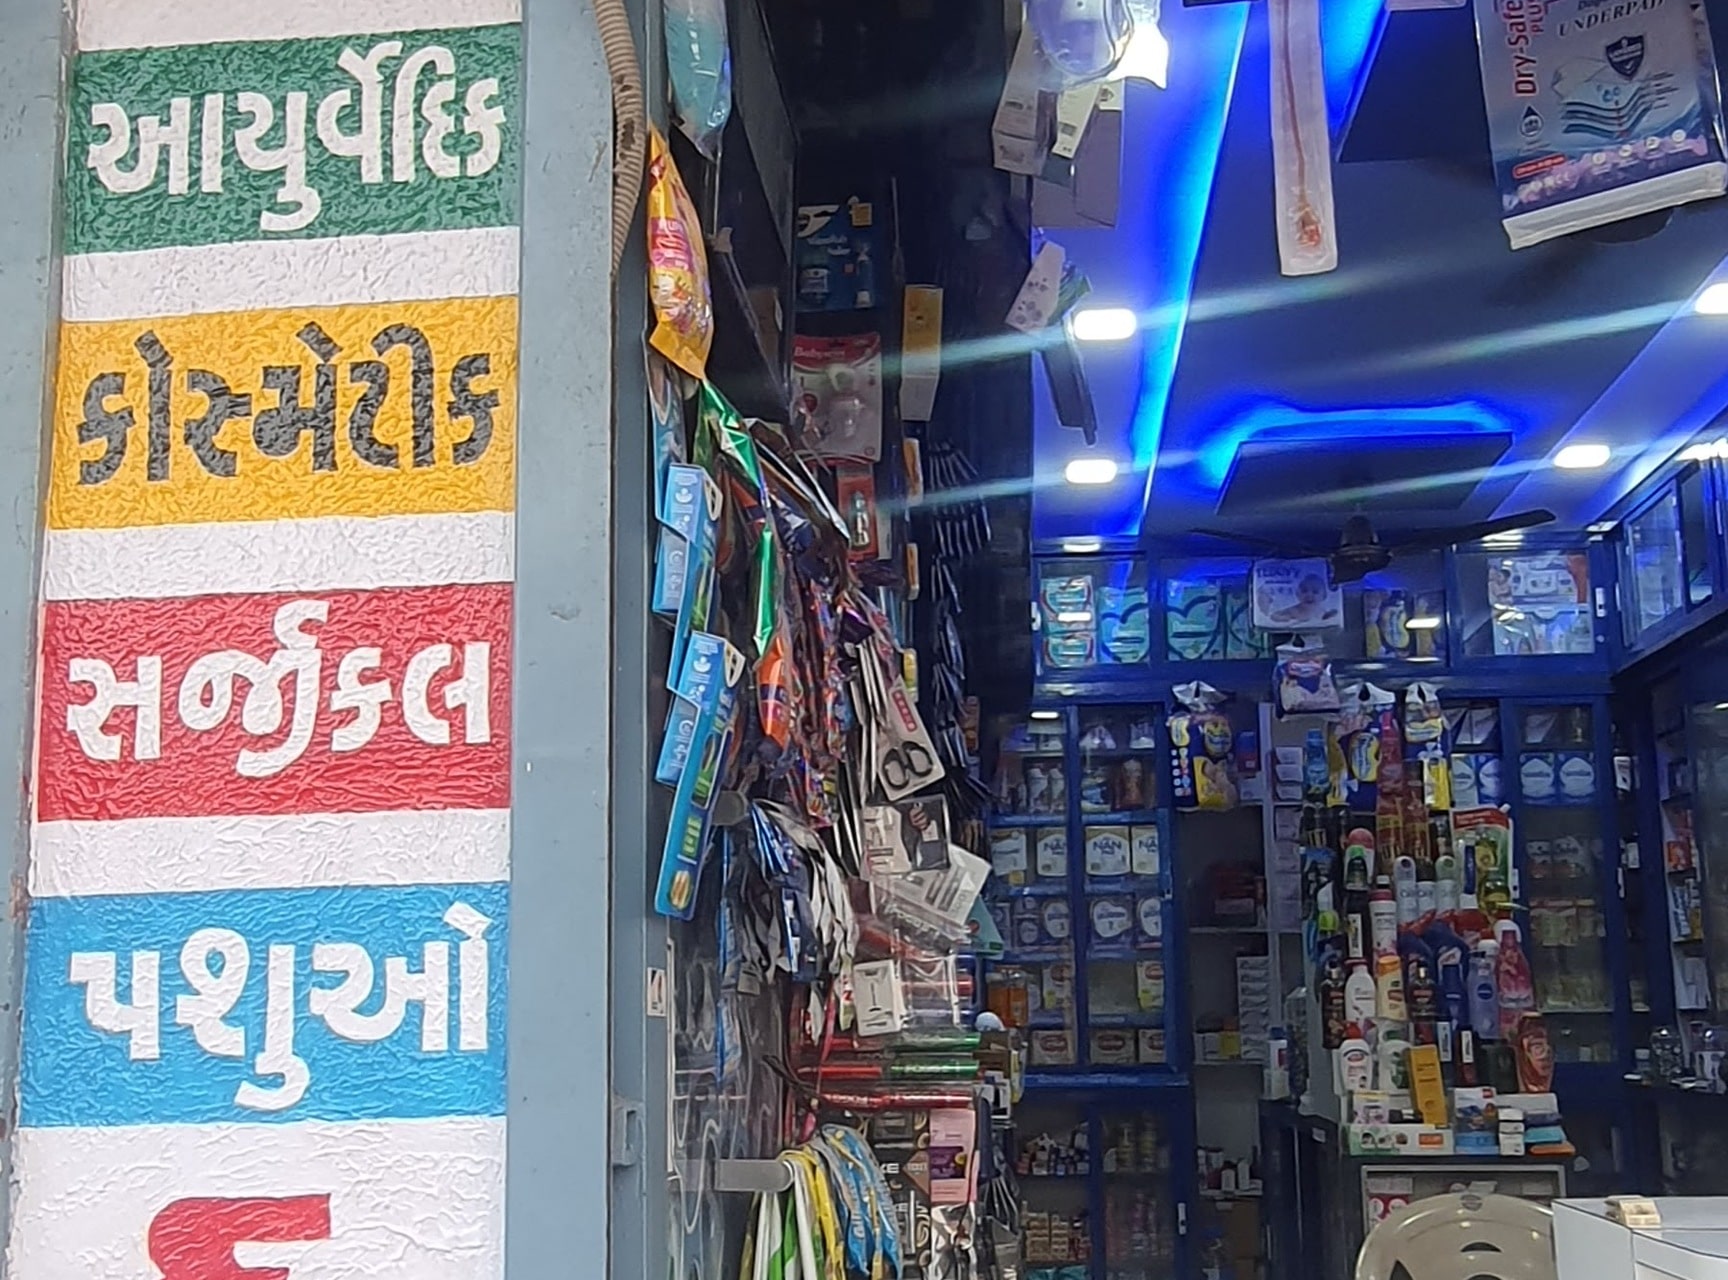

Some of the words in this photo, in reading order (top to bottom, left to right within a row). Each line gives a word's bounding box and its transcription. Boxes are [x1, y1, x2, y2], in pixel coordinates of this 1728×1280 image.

[77, 321, 500, 486] કોસ્મેટીક
[66, 599, 491, 779] સર્જીકલ
[69, 900, 495, 1111] પશુઓ
